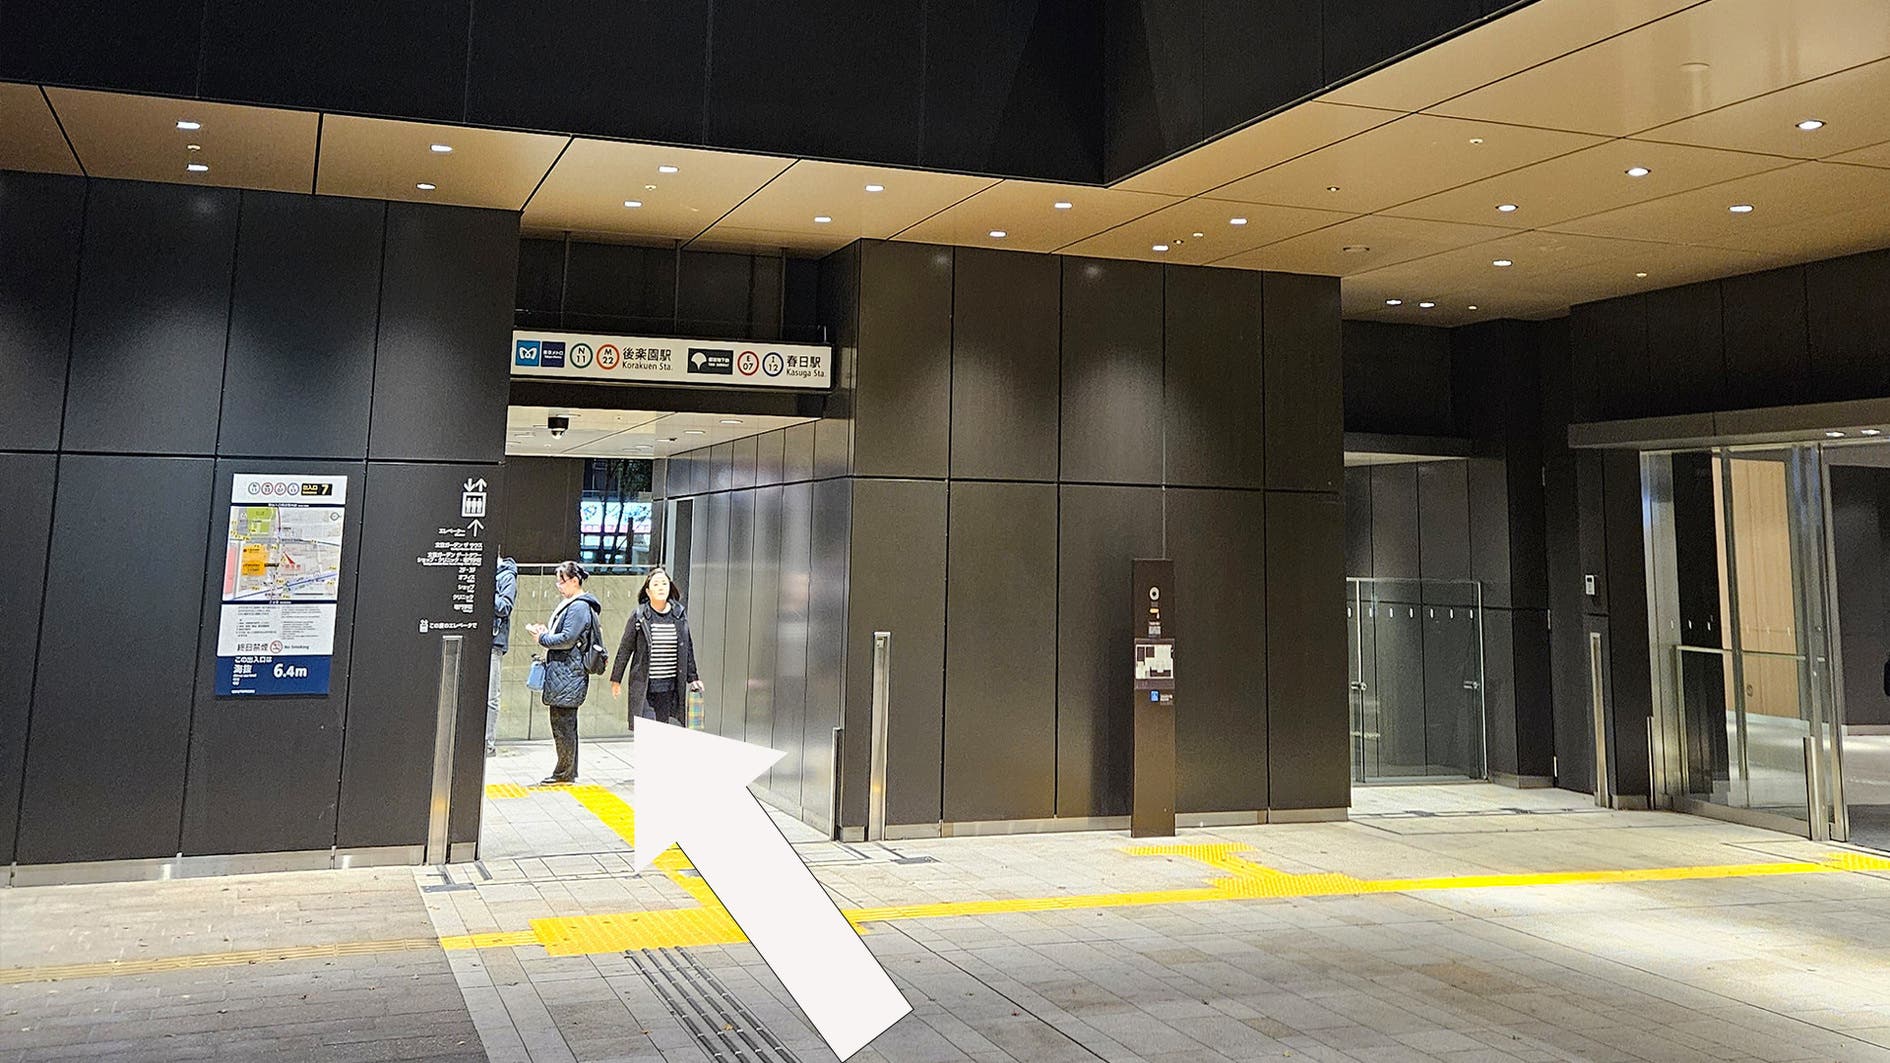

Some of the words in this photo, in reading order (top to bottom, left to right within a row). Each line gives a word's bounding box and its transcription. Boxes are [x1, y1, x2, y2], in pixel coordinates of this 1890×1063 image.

[578, 347, 586, 355] N
[622, 347, 672, 362] 後楽園駅
[576, 355, 586, 363] 11
[786, 355, 821, 368] 春日駅
[622, 361, 658, 370] Korakuen
[659, 362, 673, 371] Sta.
[743, 362, 754, 370] 07
[768, 364, 779, 372] 12
[786, 369, 812, 378] Kasuga
[321, 484, 329, 495] 7
[237, 643, 268, 651] 終日禁煙
[273, 663, 308, 677] 6.4m
